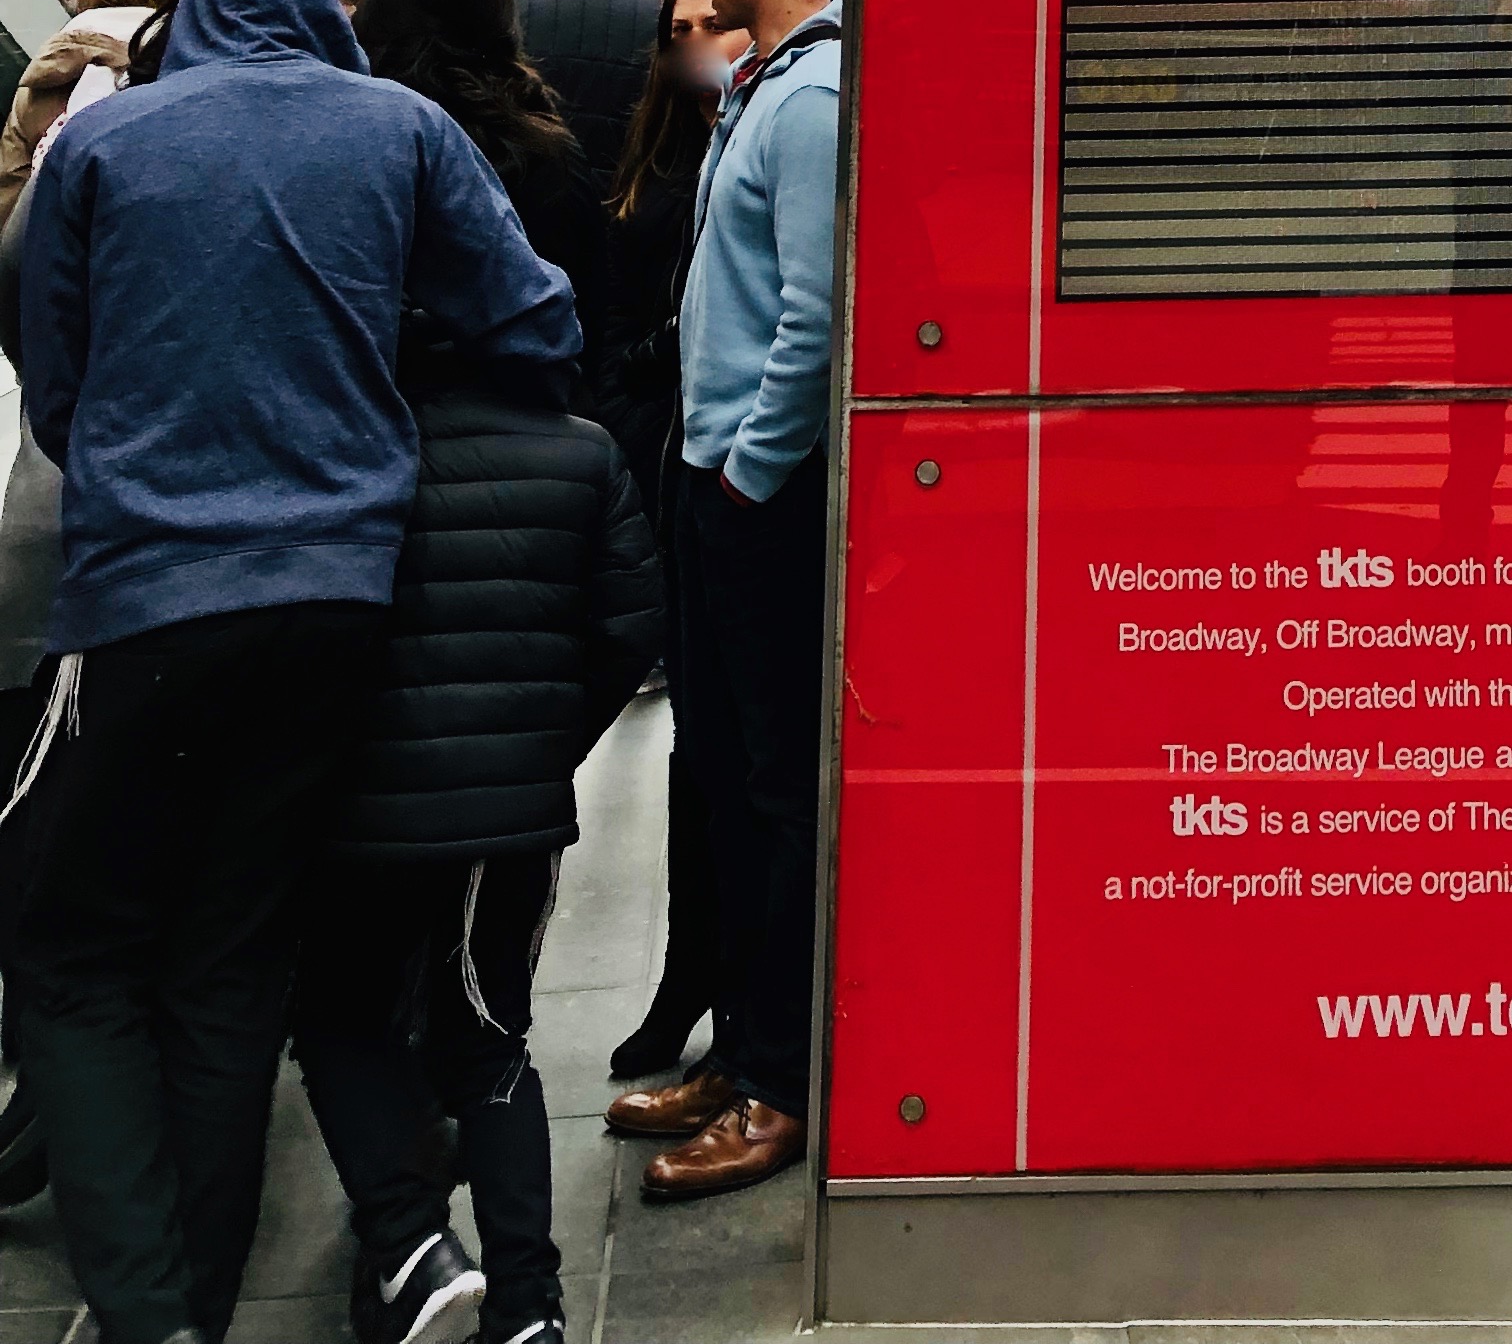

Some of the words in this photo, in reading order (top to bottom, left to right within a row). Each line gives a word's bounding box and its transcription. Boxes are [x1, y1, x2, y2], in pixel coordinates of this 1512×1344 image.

[1088, 561, 1223, 593] Welcome
[1229, 562, 1257, 591] to
[1264, 560, 1309, 591] the
[1316, 547, 1396, 590] tkts
[1406, 556, 1486, 588] booth
[1118, 622, 1269, 658] Broadway,
[1275, 619, 1320, 650] Off
[1326, 618, 1477, 653] Broadway,
[1282, 679, 1417, 717] Operated
[1424, 678, 1481, 709] with
[1161, 744, 1218, 775] The
[1226, 741, 1370, 779] Broadway
[1376, 741, 1486, 778] League
[1169, 793, 1249, 837] tkts
[1259, 804, 1284, 835] is
[1290, 809, 1311, 834] a
[1317, 802, 1421, 834] service
[1427, 801, 1457, 832] of
[1103, 876, 1124, 901] a
[1130, 866, 1304, 906] not-for-profit
[1309, 864, 1413, 898] service
